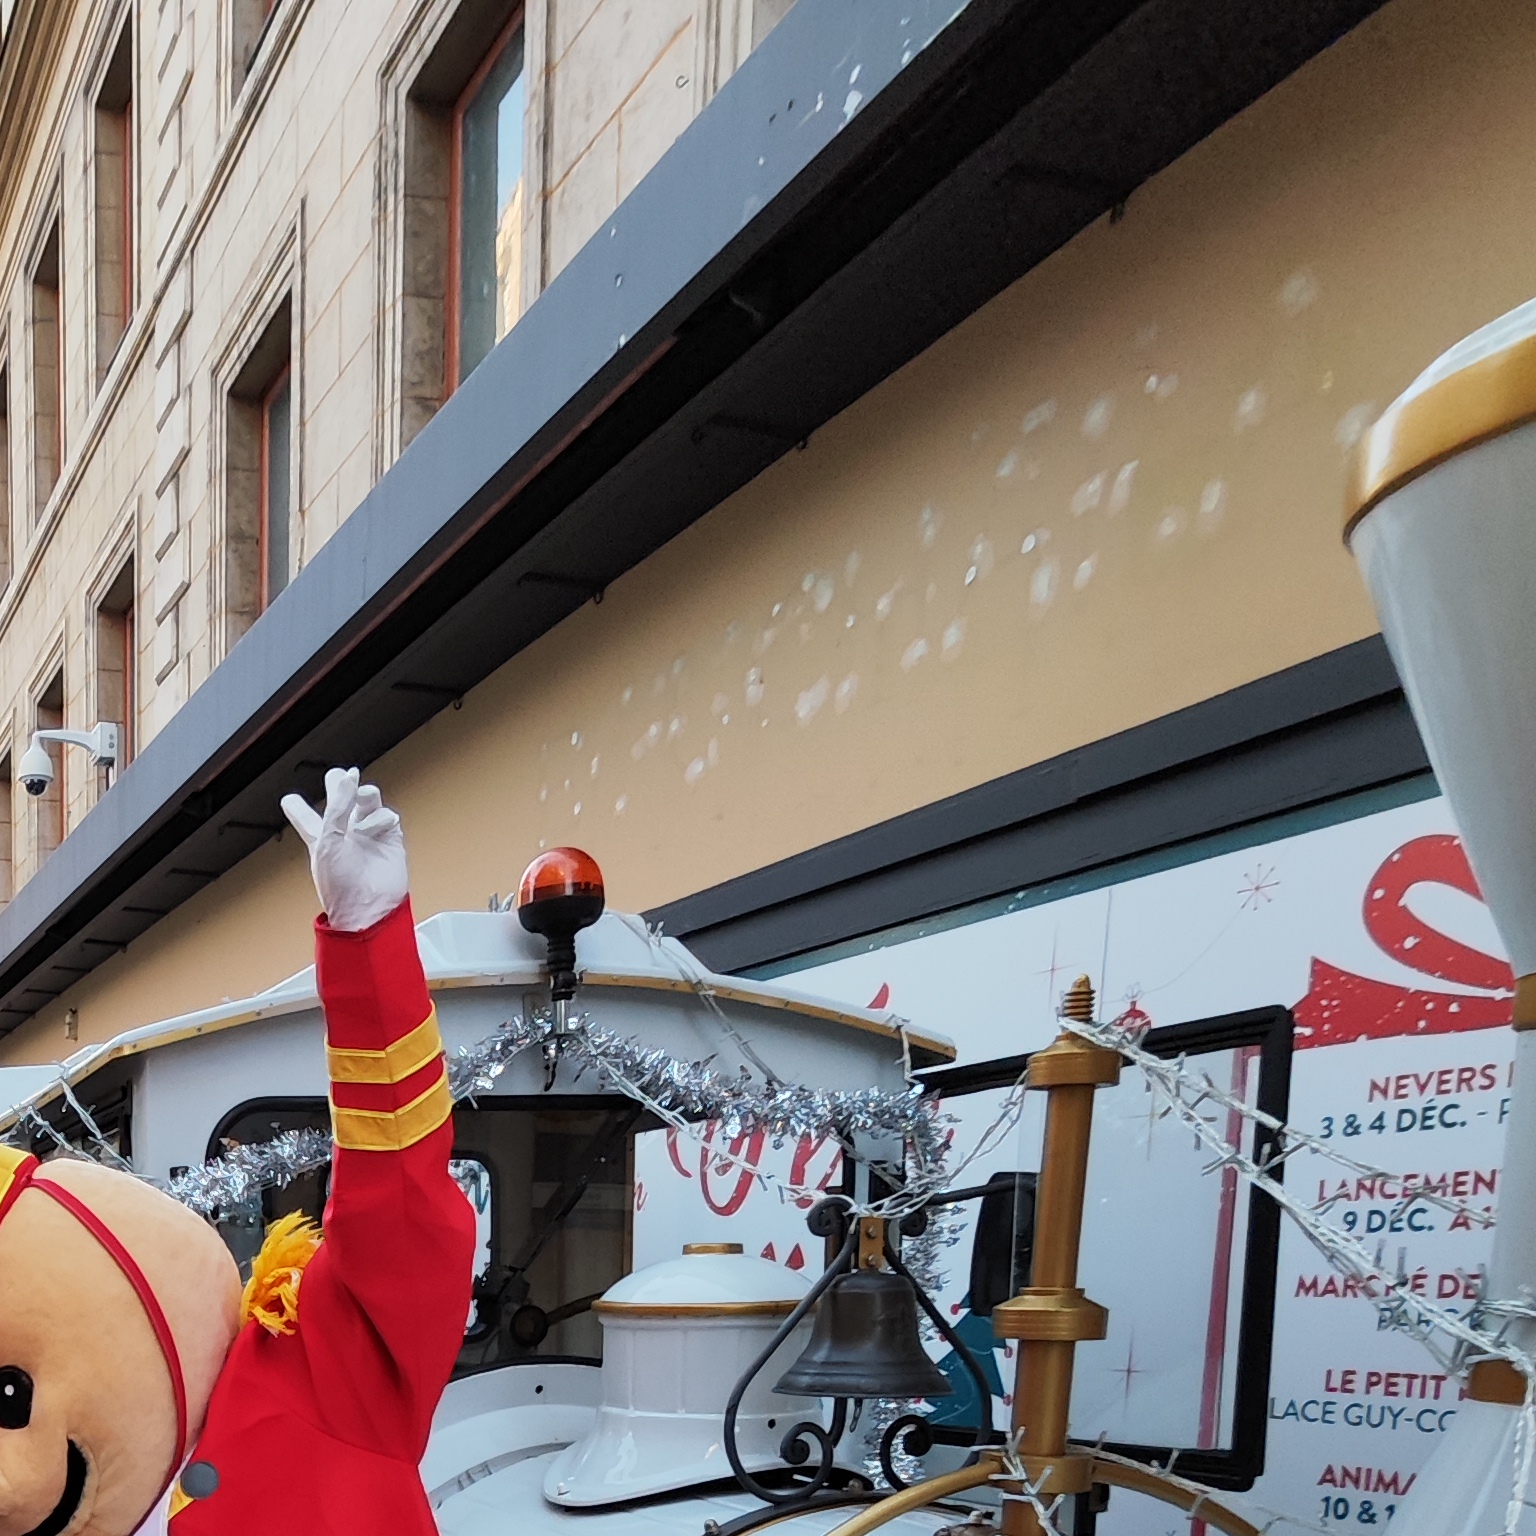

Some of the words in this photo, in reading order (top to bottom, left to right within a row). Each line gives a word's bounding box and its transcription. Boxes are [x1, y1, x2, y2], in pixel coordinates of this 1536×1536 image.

[1368, 1063, 1497, 1102] NEVERS
[1320, 1116, 1333, 1138] 3
[1343, 1114, 1361, 1136] &
[1368, 1111, 1386, 1134] 4
[1396, 1098, 1467, 1133] DÉC.
[1318, 1169, 1497, 1202] LANCEMEN
[1343, 1211, 1357, 1232] 9
[1365, 1202, 1435, 1233] DÉC.
[1325, 1369, 1357, 1393] LE
[1364, 1371, 1447, 1400] PETIT
[1268, 1397, 1337, 1424] LACE
[1321, 1496, 1350, 1520] 10
[1357, 1500, 1377, 1524] &
